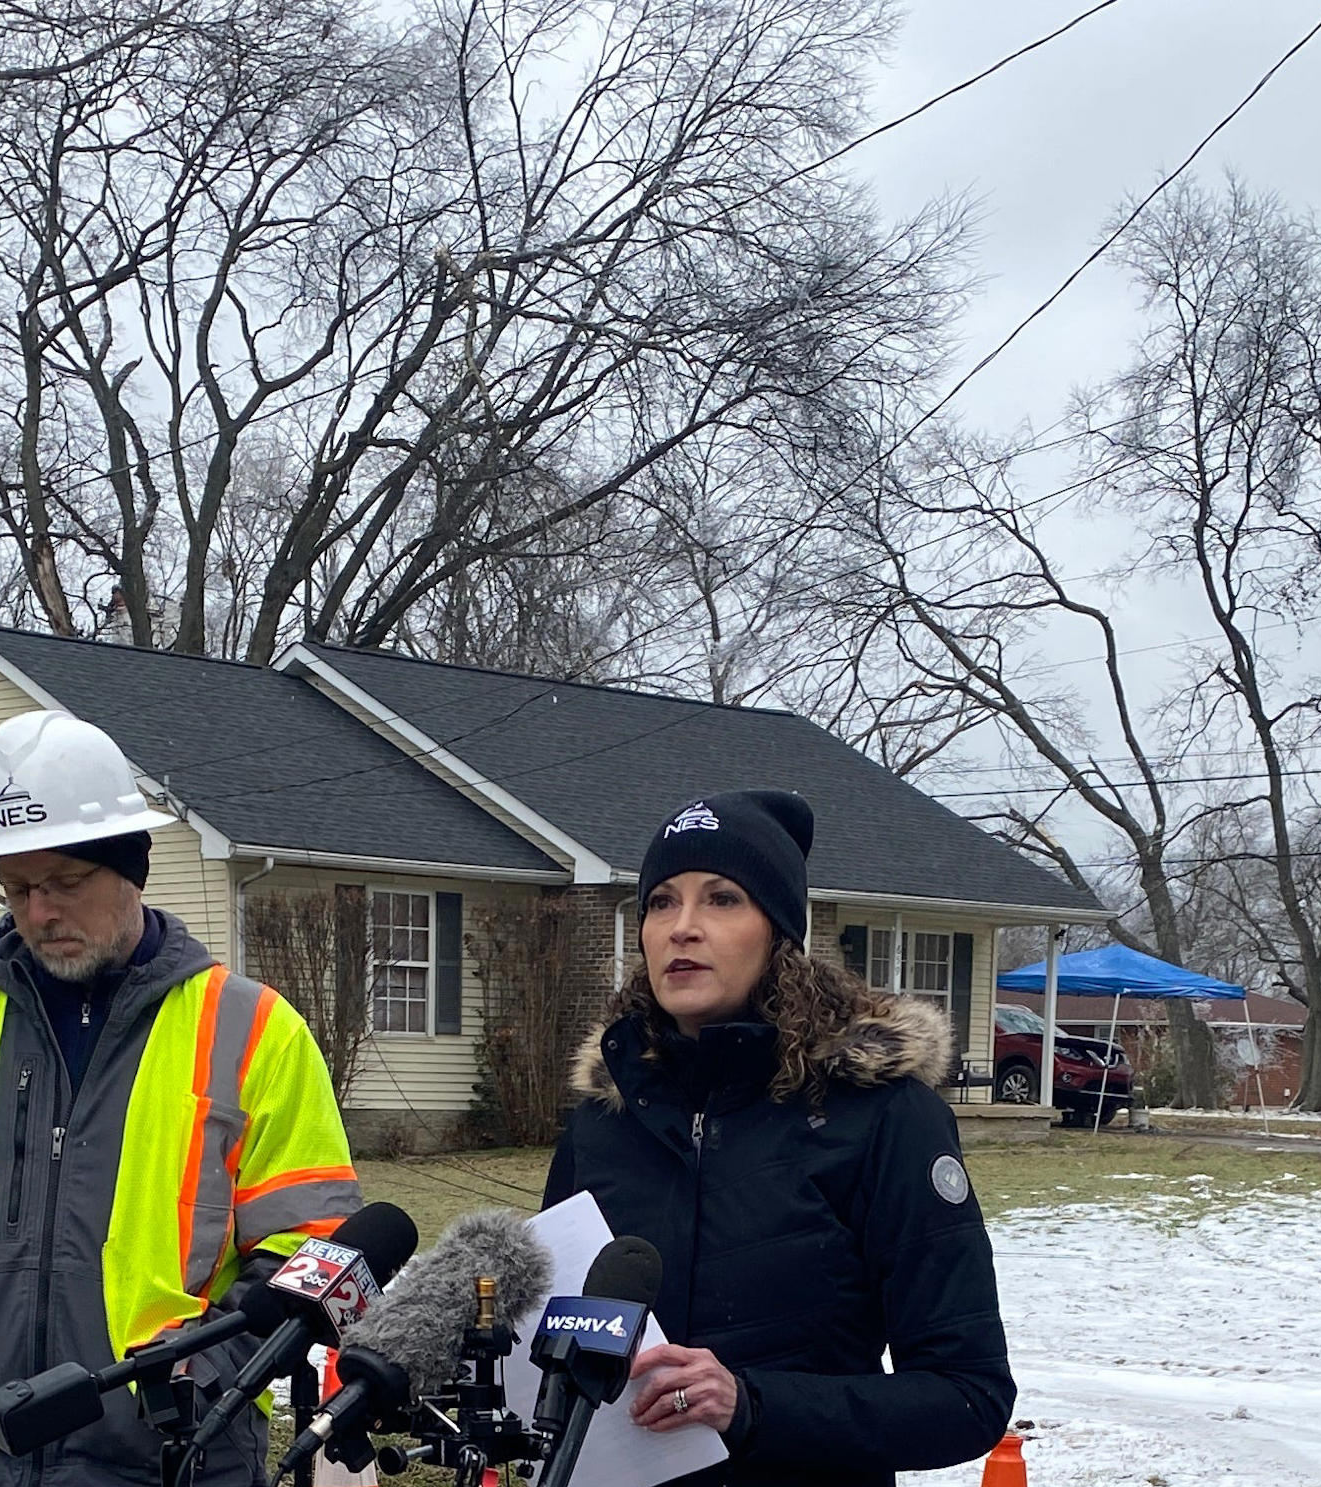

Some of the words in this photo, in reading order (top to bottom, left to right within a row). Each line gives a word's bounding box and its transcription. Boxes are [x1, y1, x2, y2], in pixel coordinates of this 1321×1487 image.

[664, 817, 720, 839] NES
[302, 1240, 354, 1264] NEWS
[274, 1256, 319, 1289] 2
[303, 1273, 329, 1288] abc
[353, 1261, 381, 1299] NEW
[326, 1280, 359, 1326] 2
